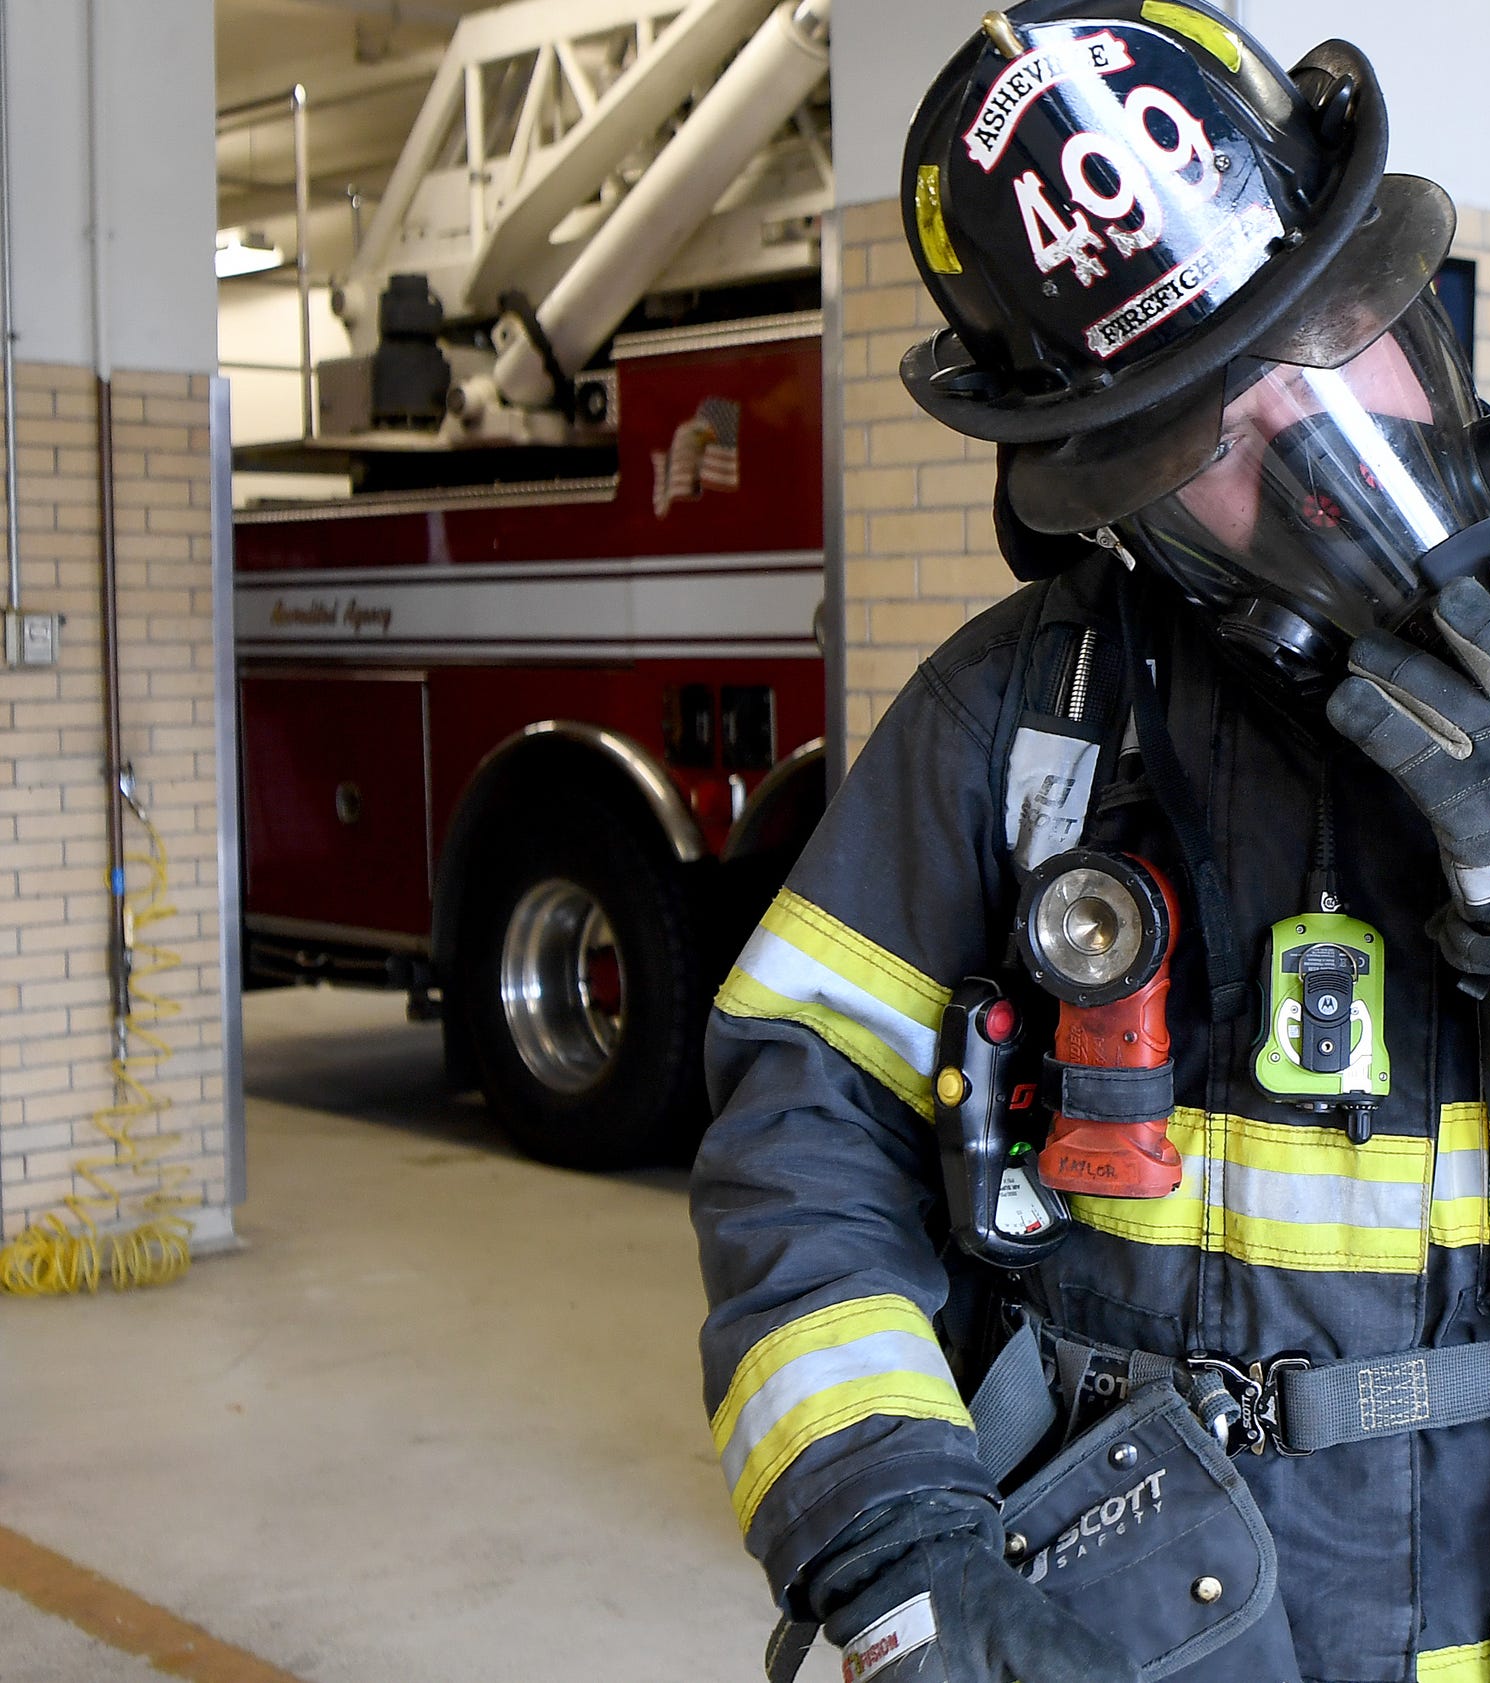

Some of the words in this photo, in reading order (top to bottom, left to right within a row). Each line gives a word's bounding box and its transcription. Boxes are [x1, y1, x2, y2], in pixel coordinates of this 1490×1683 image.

[974, 44, 1109, 152] ASHEVIE
[1013, 84, 1222, 288] 499
[1241, 1394, 1253, 1430] SCOTT
[1055, 1468, 1167, 1554] SCOTT
[1056, 1500, 1164, 1569] SAFETY
